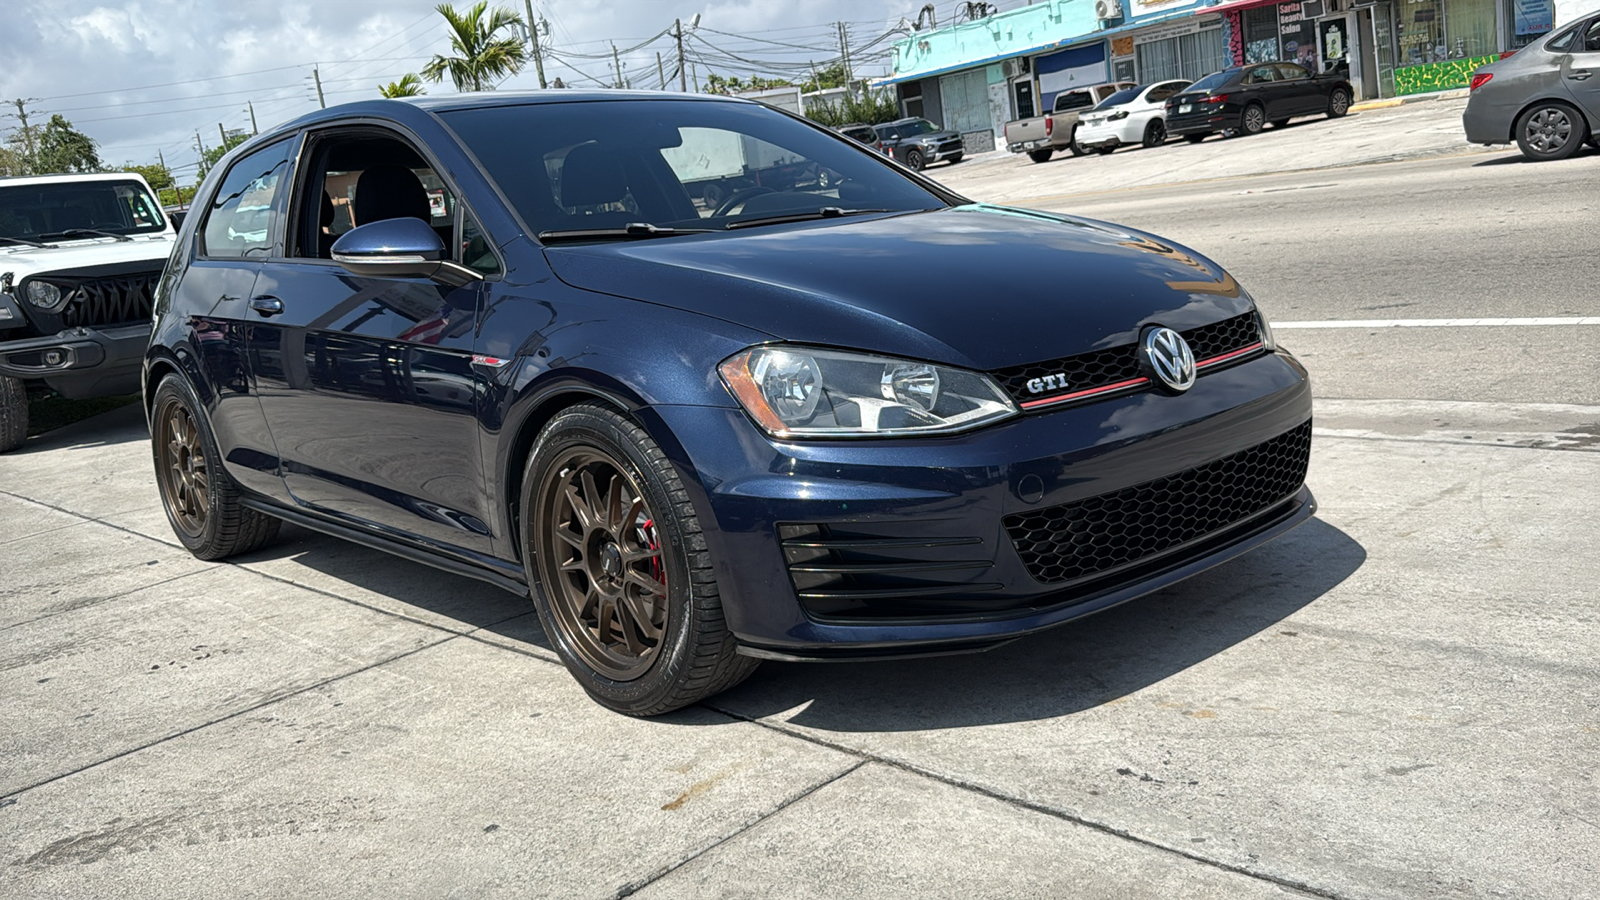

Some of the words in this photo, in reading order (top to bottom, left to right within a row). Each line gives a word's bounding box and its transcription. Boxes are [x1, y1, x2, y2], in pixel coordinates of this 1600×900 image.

[1279, 3, 1300, 14] Sarita
[1281, 24, 1301, 34] Salon
[1026, 372, 1069, 393] GTI
